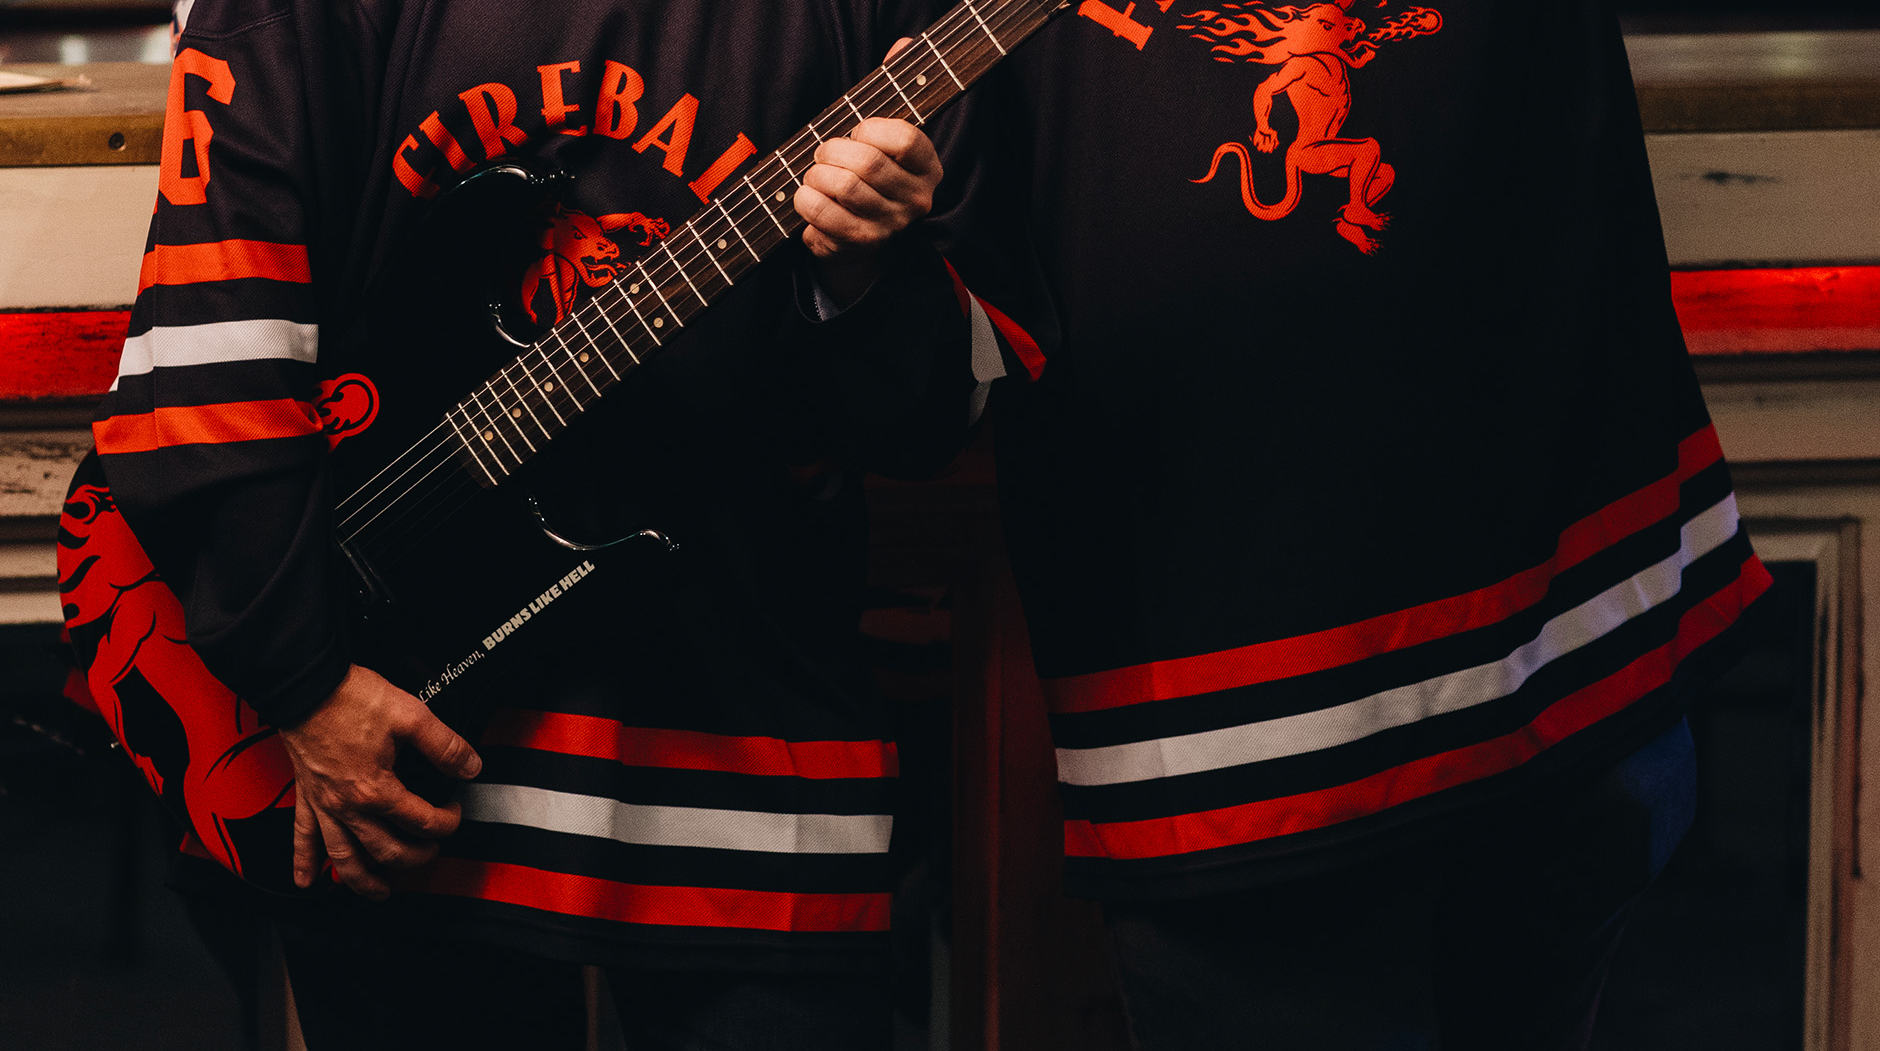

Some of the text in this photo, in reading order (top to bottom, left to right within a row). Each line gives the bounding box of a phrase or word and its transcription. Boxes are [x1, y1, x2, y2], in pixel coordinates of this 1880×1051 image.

[392, 59, 758, 204] FIREBAL
[418, 560, 596, 704] Like Heaven, BURNS LIKE HELL
